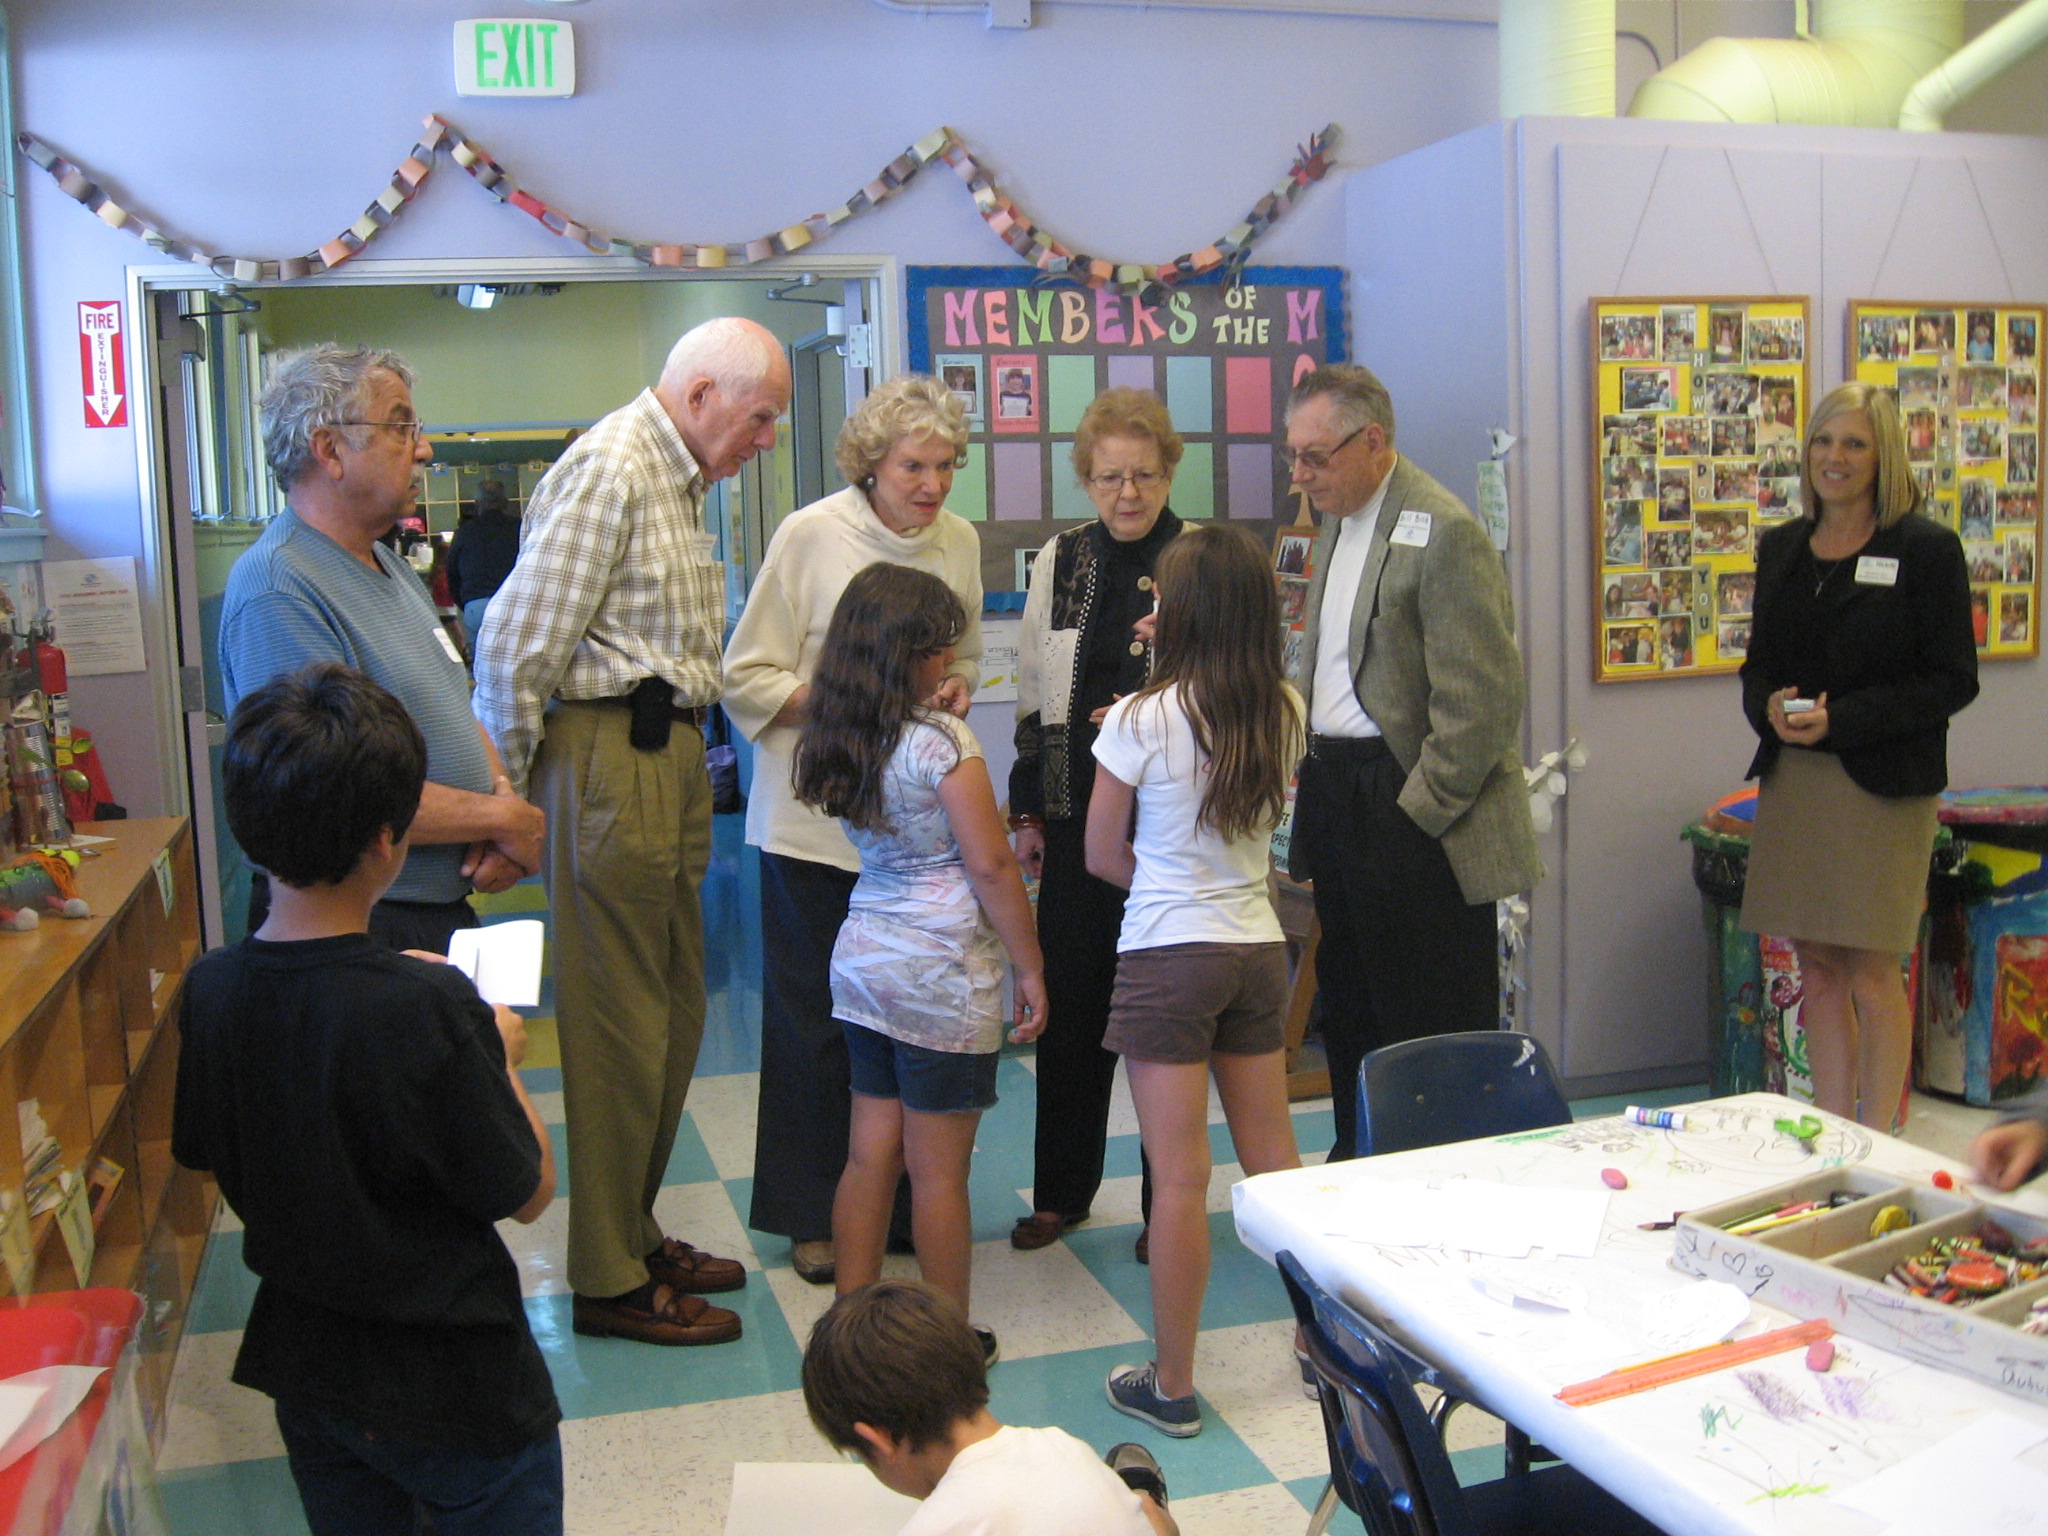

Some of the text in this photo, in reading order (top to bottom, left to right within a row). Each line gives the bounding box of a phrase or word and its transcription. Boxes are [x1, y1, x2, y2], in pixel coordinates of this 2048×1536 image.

[475, 23, 558, 87] EXIT
[85, 313, 114, 329] FIRE
[943, 288, 1198, 347] MEMBERS
[1225, 285, 1257, 310] OF
[1212, 314, 1271, 345] THE
[97, 332, 110, 416] EXTINGUISHER
[1693, 353, 1709, 630] HOW DO YOU
